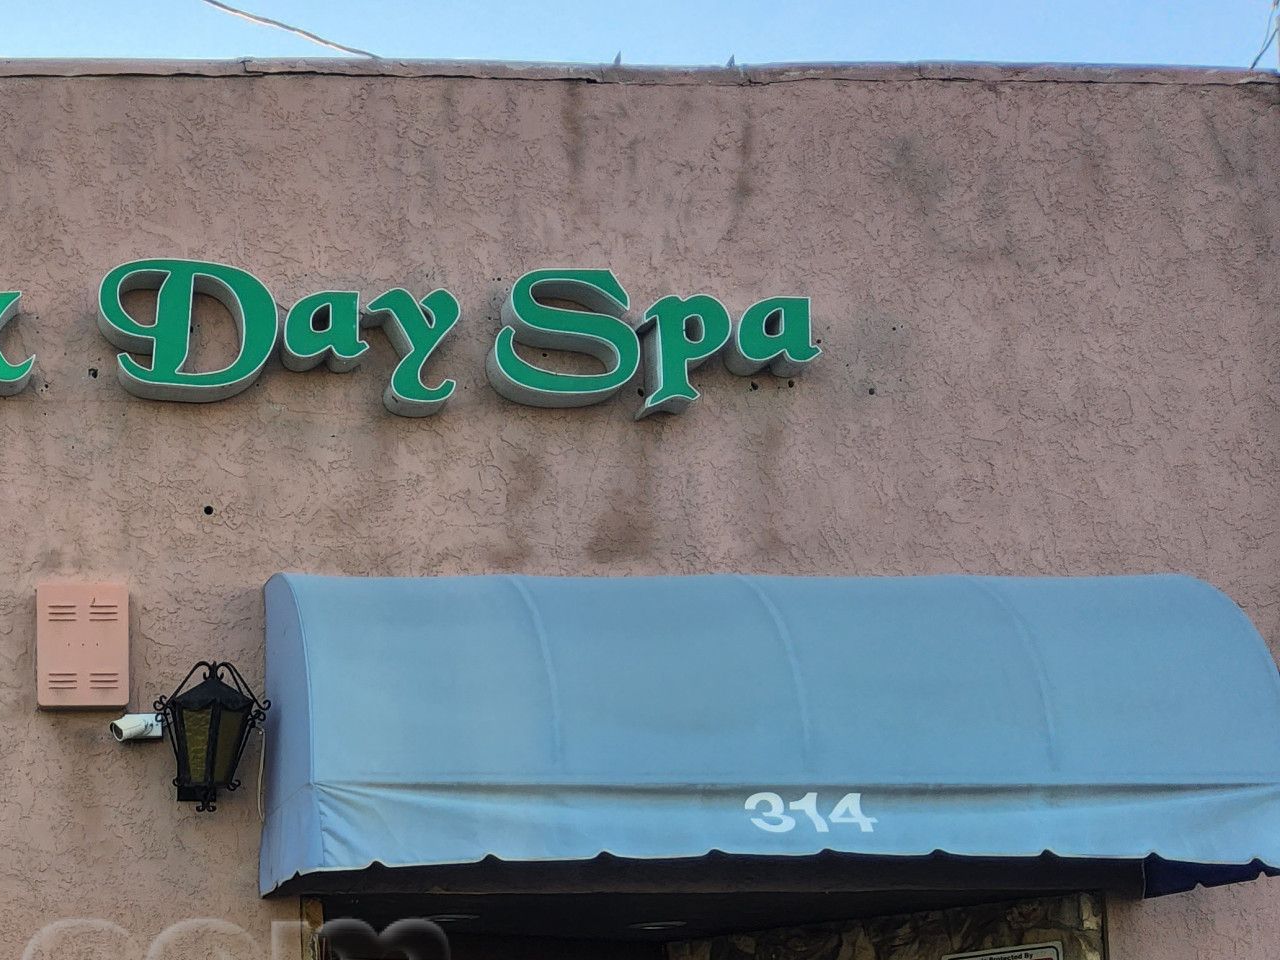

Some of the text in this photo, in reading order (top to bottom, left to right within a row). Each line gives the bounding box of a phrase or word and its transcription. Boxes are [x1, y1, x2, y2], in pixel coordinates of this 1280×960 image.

[97, 257, 462, 403] Day
[493, 266, 823, 407] Spa
[743, 791, 880, 834] 314
